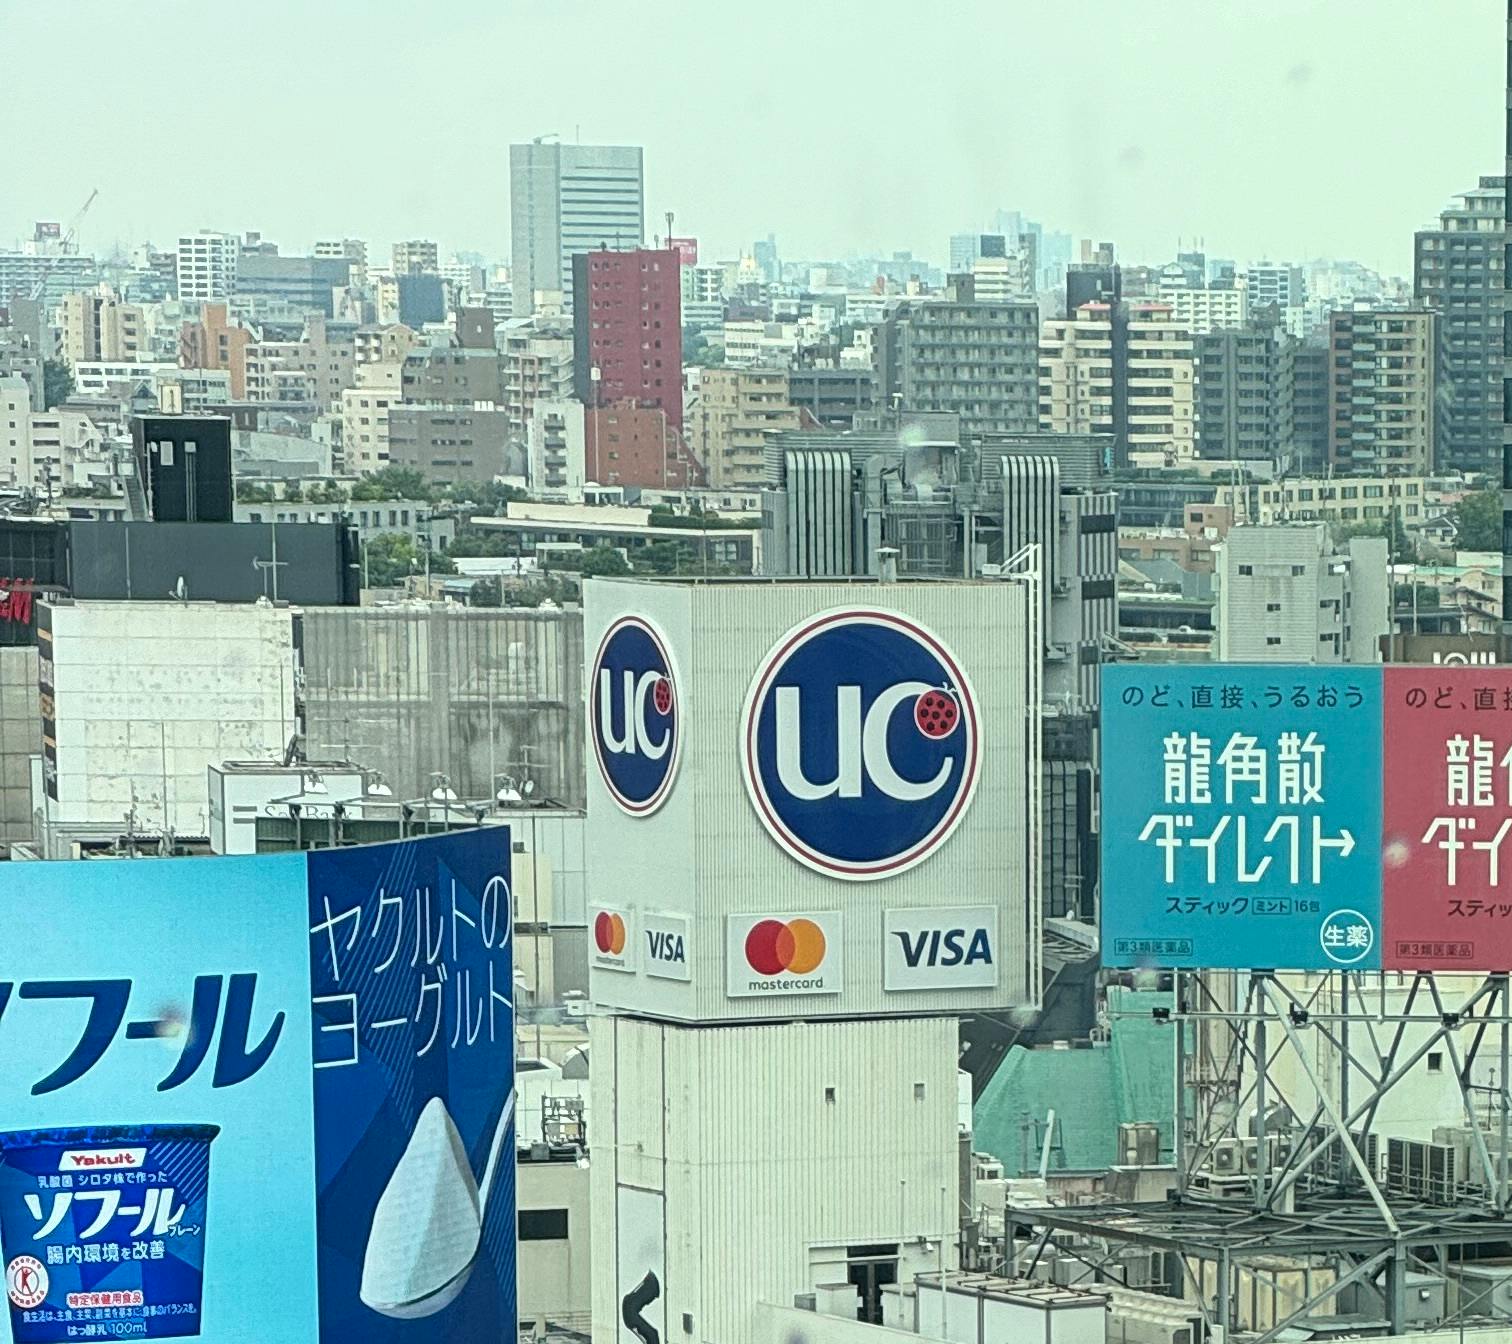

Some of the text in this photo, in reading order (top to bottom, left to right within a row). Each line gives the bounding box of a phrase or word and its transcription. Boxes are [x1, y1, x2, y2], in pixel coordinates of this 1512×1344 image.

[1121, 684, 1366, 710] のど、直接、うるおう
[1163, 731, 1326, 805] 龍角散
[1138, 812, 1356, 885] ダイレクト
[1165, 896, 1249, 916] スティック
[310, 873, 512, 983] ヤクルトの
[1323, 924, 1370, 948] 生薬
[645, 929, 685, 963] VISA
[891, 928, 992, 967] VISA
[749, 976, 823, 991] mastercard
[312, 961, 514, 1069] ヨーグルト
[0, 972, 285, 1097] フール
[70, 1153, 136, 1167] Yakult
[24, 1188, 186, 1240] ソフール
[47, 1240, 165, 1265] 腸内環境を改善
[111, 1322, 147, 1336] 100ml
